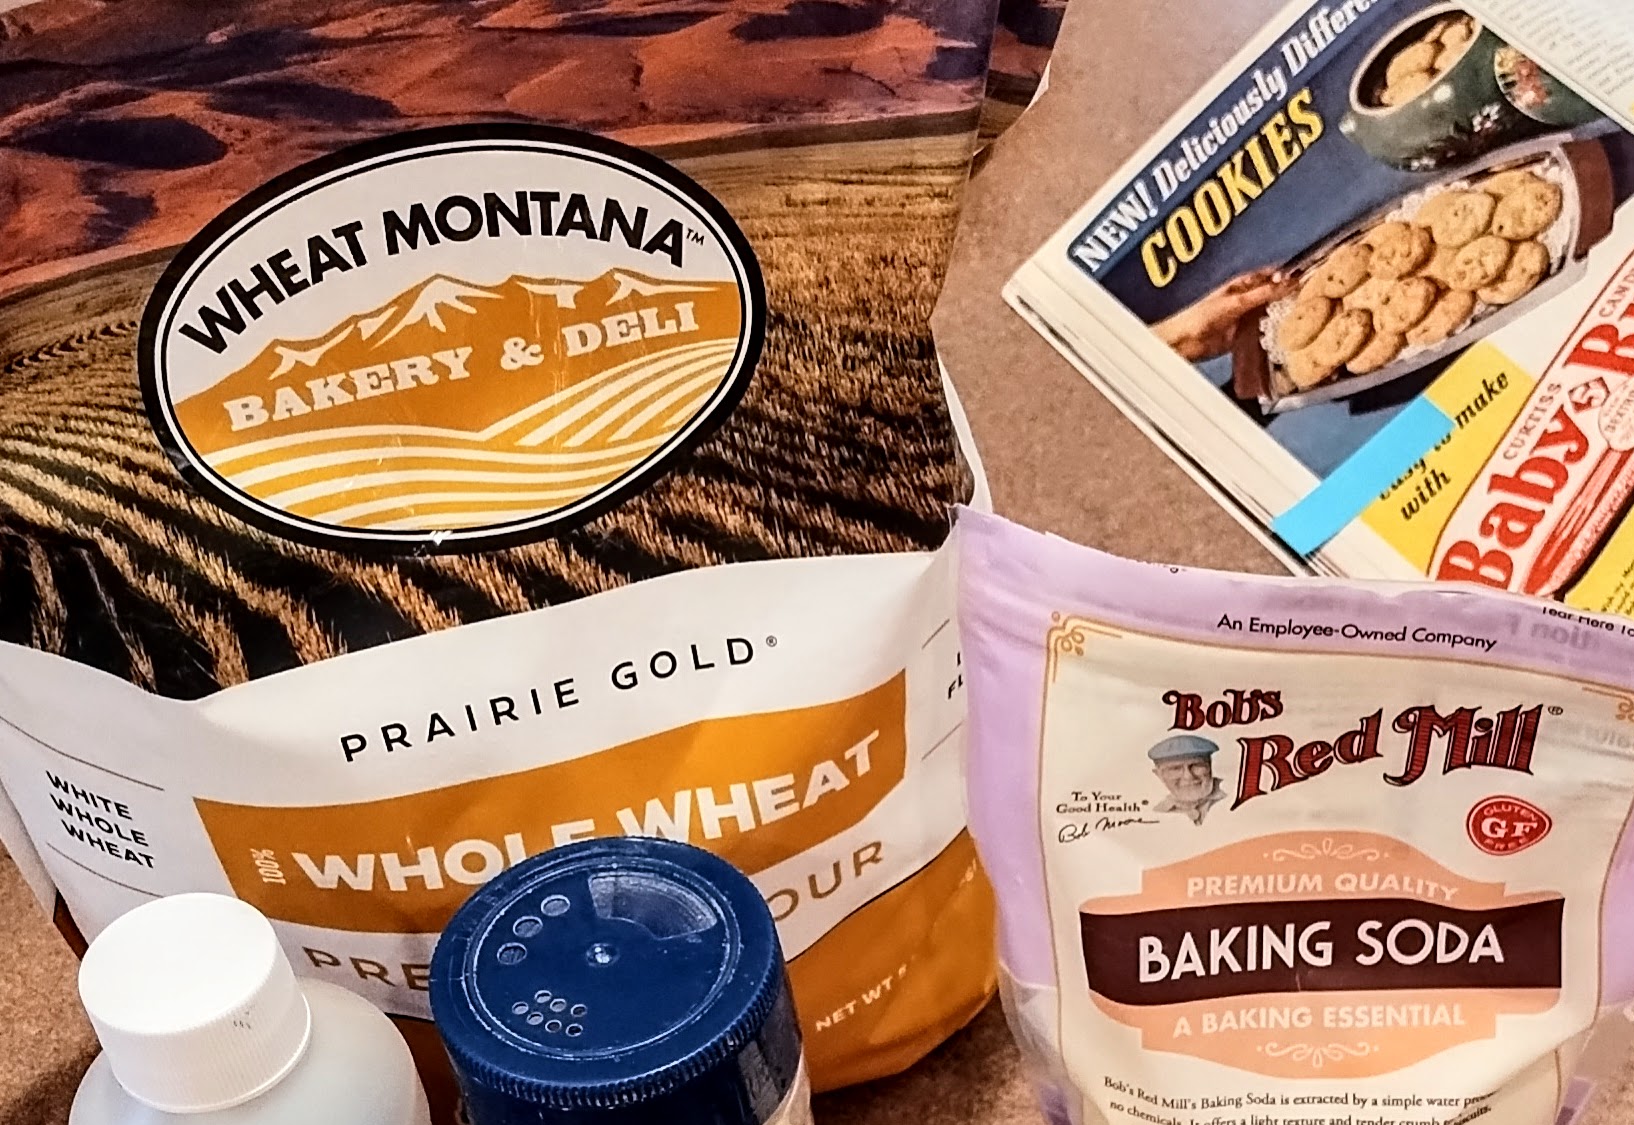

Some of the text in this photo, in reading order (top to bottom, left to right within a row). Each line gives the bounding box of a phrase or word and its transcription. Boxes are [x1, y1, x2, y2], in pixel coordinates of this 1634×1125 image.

[1072, 65, 1289, 273] NEW! Deliciously
[1140, 87, 1324, 288] COOKIES
[179, 223, 373, 355] WHEAT
[223, 300, 701, 431] BAKERY & DELI
[1456, 372, 1509, 430] make
[1503, 383, 1561, 460] CURTISS
[1400, 469, 1451, 521] with
[1435, 403, 1590, 592] Baby
[1217, 616, 1497, 652] An Employee-Owned Company
[341, 678, 581, 764] PRAIRIE
[1162, 688, 1284, 731] Bob's
[1230, 708, 1383, 811] Red
[45, 770, 133, 820] WHITE
[50, 795, 148, 848] WHOLE
[251, 730, 883, 886] 100% WHEAT
[62, 820, 155, 871] WHEAT
[1480, 816, 1540, 839] GF
[1187, 871, 1460, 904] PREMIUM QUALITY
[1138, 917, 1505, 983] BAKING SODA
[1172, 1001, 1466, 1039] A BAKING ESSENTIAL
[1104, 1076, 1133, 1095] Bob's
[1137, 1087, 1157, 1105] Red
[1161, 1097, 1196, 1109] Mill's
[1201, 1095, 1242, 1109] Baking
[1245, 1092, 1275, 1104] Soda
[1280, 1094, 1289, 1104] is
[1292, 1092, 1348, 1104] extracted
[1352, 1093, 1367, 1108] by
[1371, 1098, 1377, 1106] a
[1426, 1098, 1459, 1106] water
